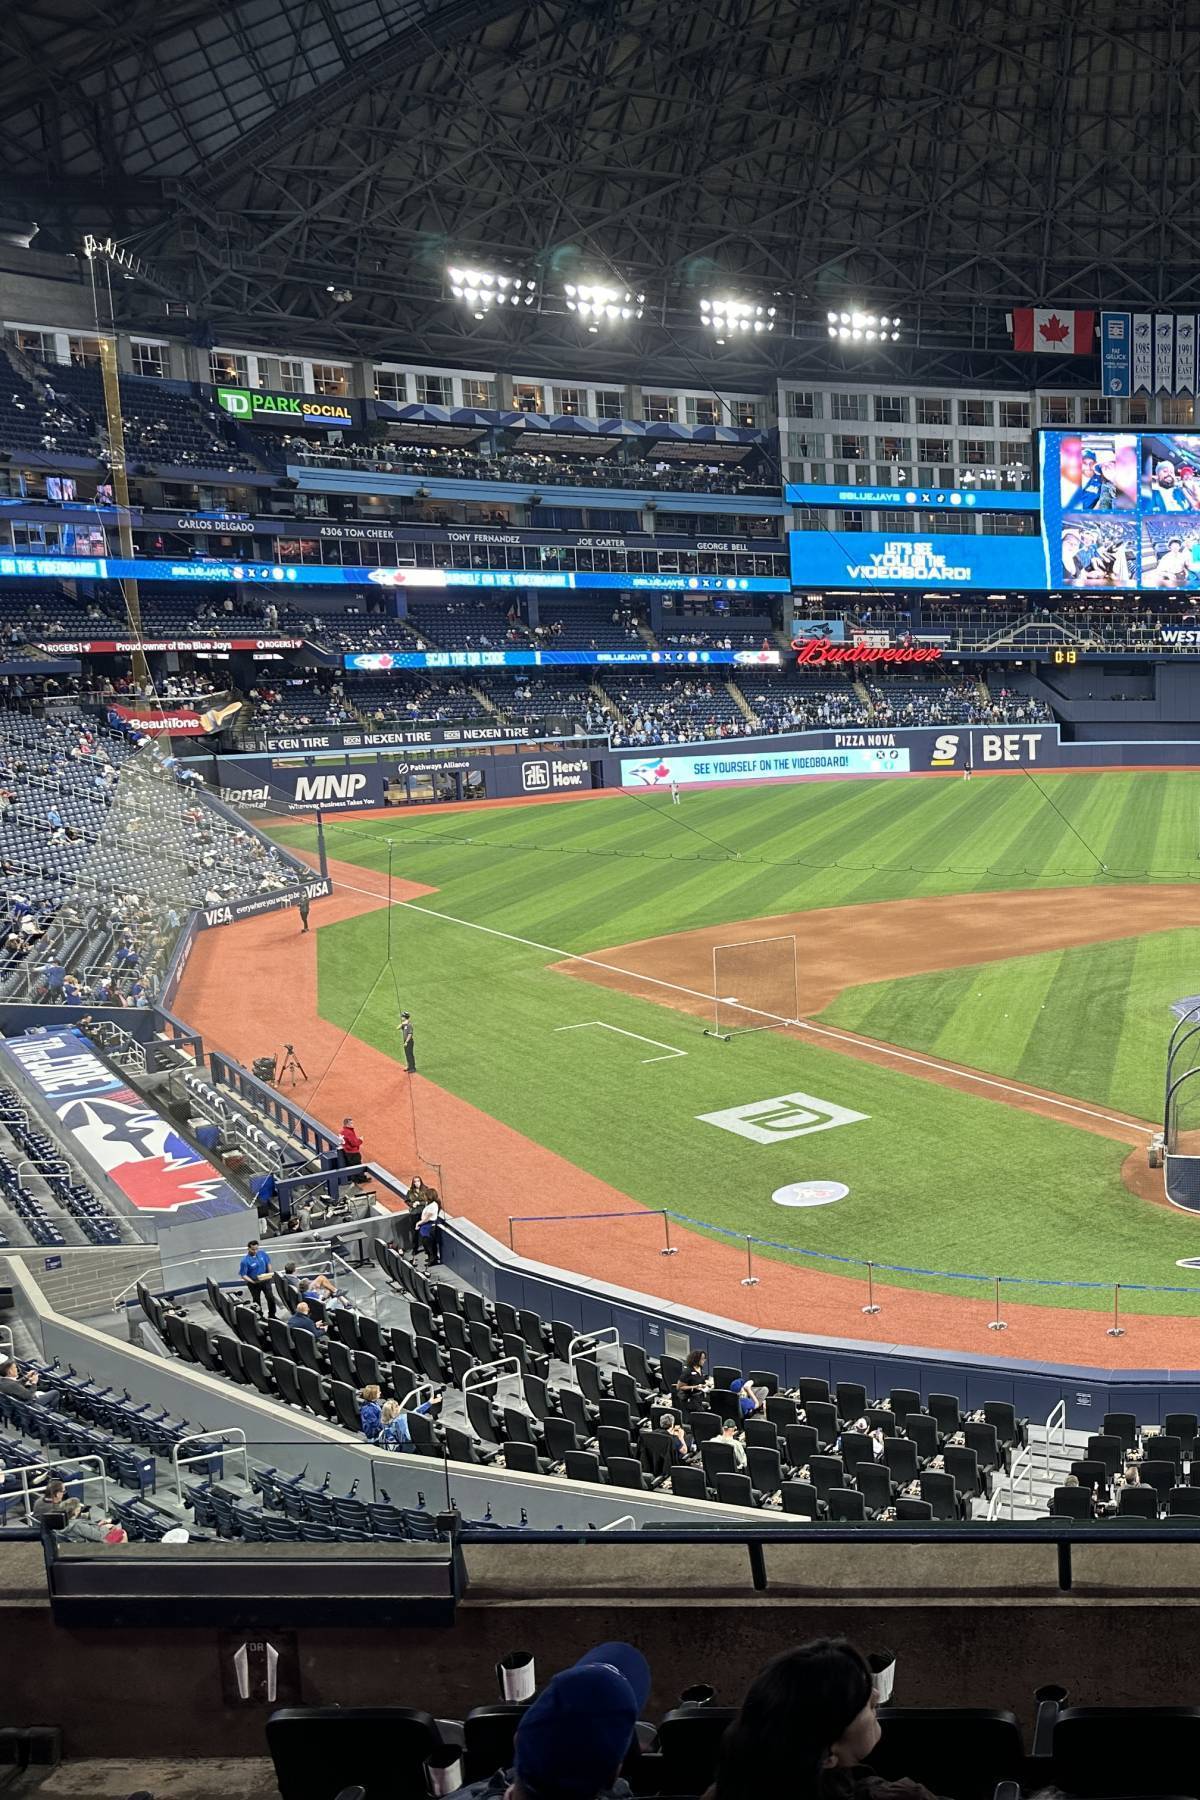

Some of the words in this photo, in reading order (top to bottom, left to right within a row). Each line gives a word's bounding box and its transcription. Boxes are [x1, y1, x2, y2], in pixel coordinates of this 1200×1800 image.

[1135, 343, 1150, 354] 1985
[1157, 343, 1171, 354] 1989
[1178, 344, 1192, 355] 1991
[1135, 366, 1150, 374] EAST
[1157, 366, 1170, 374] EAST
[1178, 367, 1192, 375] EAST
[221, 394, 249, 413] TD
[253, 395, 301, 412] PARK
[302, 403, 352, 418] SOCIAL
[178, 519, 212, 530] CARLOS
[215, 521, 255, 532] DELGADO
[320, 527, 342, 537] 4306
[344, 528, 365, 538] TOM
[367, 529, 394, 539] CHEEK
[448, 533, 471, 542] TONY
[474, 534, 520, 543] FERNANDEZ
[577, 538, 593, 546] JOE
[596, 539, 625, 547] CARTER
[697, 542, 728, 551] GEORGE
[732, 543, 748, 551] BELL
[870, 554, 908, 567] YOU
[846, 565, 971, 580] VIDEOBOARD!
[47, 643, 79, 652] ROGERS
[116, 642, 141, 651] Proud
[143, 643, 167, 651] owner
[167, 641, 176, 650] of
[176, 641, 191, 650] the
[192, 641, 210, 650] Blue
[212, 641, 232, 651] Jays
[791, 639, 942, 665] Budweiser
[130, 717, 199, 730] BeautiTone
[364, 733, 405, 745] NEXEN
[407, 731, 431, 743] TIRE
[463, 729, 502, 740] NEXEN
[503, 727, 529, 738] TIRE
[260, 738, 299, 752] NEXEN
[301, 736, 330, 748] TIRE
[835, 734, 865, 747] PIZZA
[868, 734, 895, 747] NOVA
[932, 734, 960, 760] S
[983, 733, 1042, 761] BET
[410, 763, 442, 771] Pathways
[443, 761, 470, 769] Alliance
[552, 759, 588, 773] Here's
[694, 763, 710, 775] SEE
[713, 760, 758, 773] YOURSELF
[760, 759, 772, 770] ON
[774, 758, 790, 770] THE
[791, 756, 849, 769] VIDEOBOARD!
[553, 774, 582, 787] How.
[295, 774, 366, 801] MNP
[203, 906, 233, 926] VISA
[236, 901, 267, 914] everywhere
[267, 899, 276, 907] you
[304, 881, 329, 899] VISA
